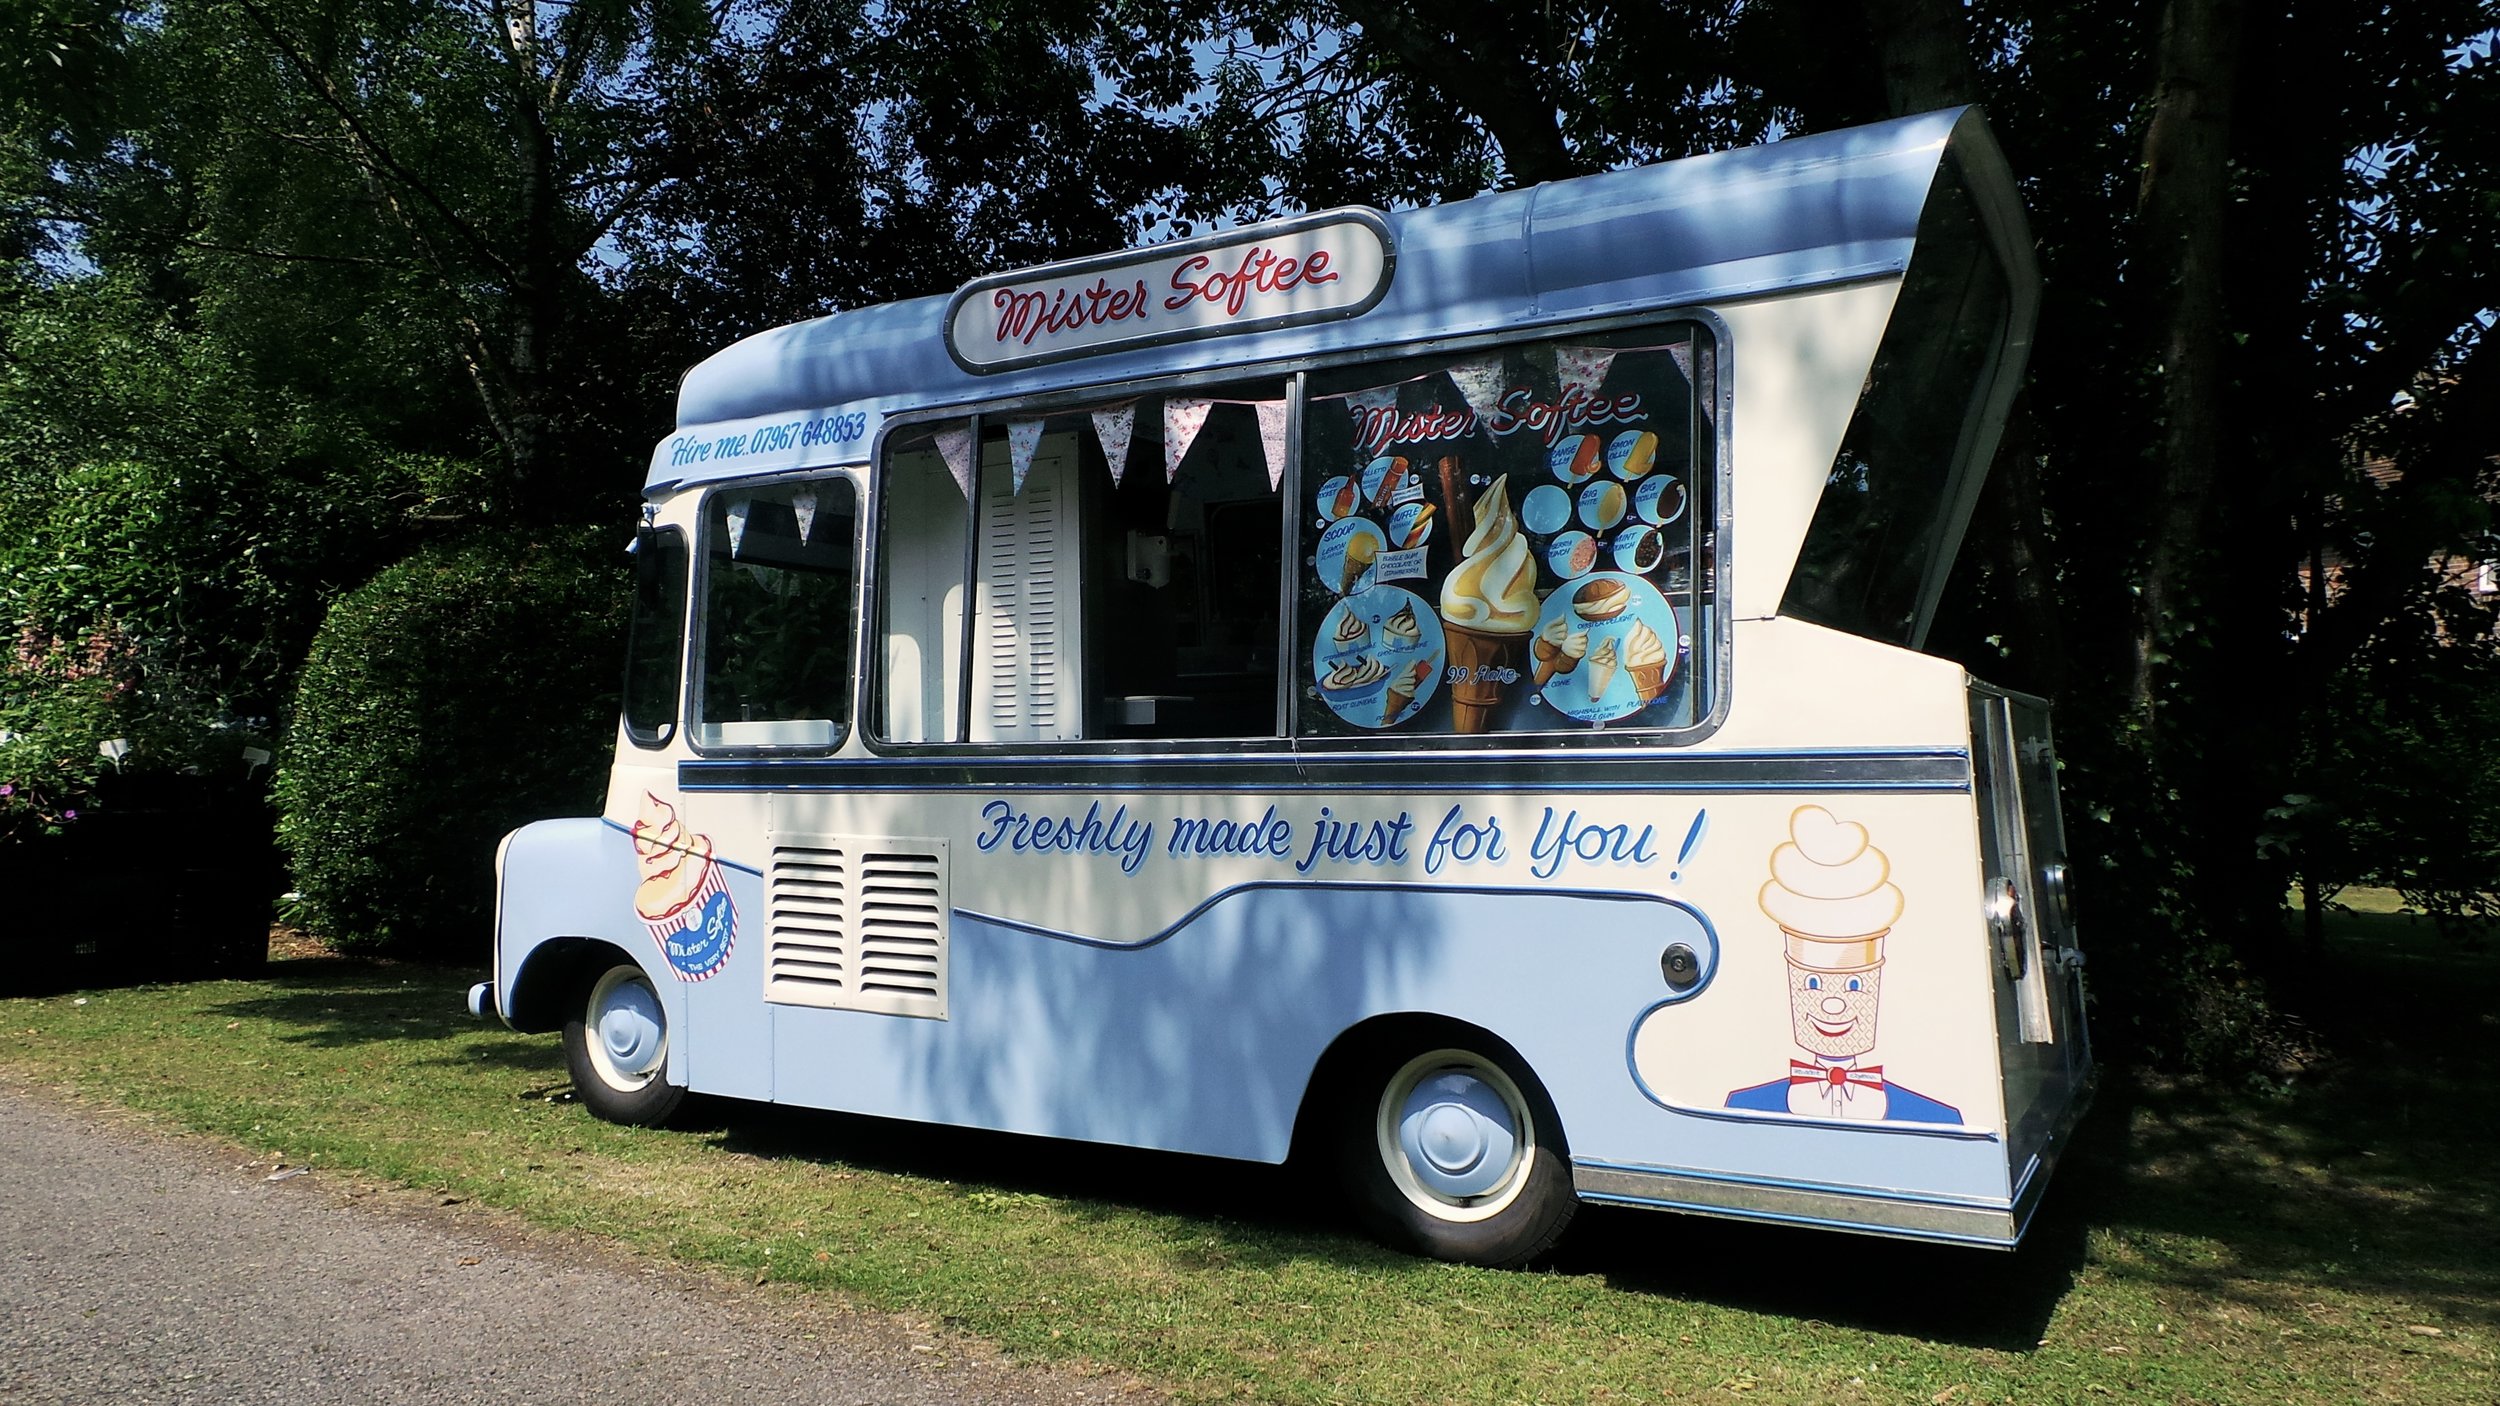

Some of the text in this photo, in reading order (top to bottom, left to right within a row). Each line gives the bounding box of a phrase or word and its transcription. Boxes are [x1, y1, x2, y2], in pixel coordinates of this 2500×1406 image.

[994, 247, 1338, 344] Mister Softee
[1350, 383, 1648, 457] Mister Softee
[671, 435, 712, 467] Hire
[1608, 438, 1635, 451] EMON
[1582, 489, 1598, 499] BIG
[1640, 482, 1656, 494] BIG
[1389, 506, 1420, 522] HUFFLE
[1323, 522, 1356, 542] SCOOP
[1446, 665, 1470, 685] 99
[1470, 664, 1521, 686] flake
[977, 799, 1153, 876] Freshly
[1168, 803, 1294, 860] made
[1295, 806, 1414, 874] just
[1424, 803, 1508, 875] for
[668, 938, 709, 958] Mister
